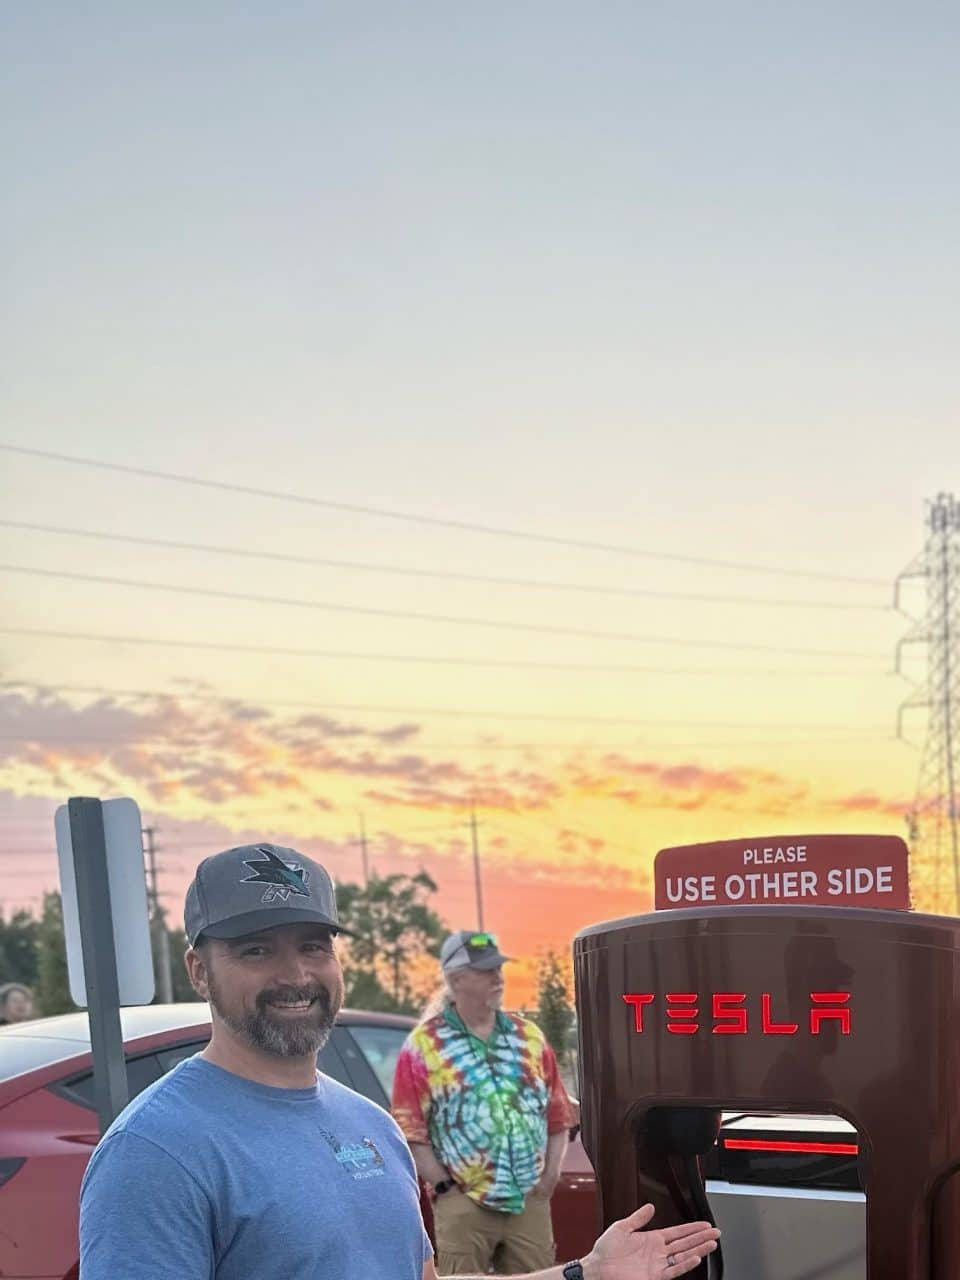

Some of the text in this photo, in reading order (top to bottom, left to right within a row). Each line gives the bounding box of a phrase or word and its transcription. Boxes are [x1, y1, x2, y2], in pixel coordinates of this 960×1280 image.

[743, 846, 807, 865] PLEASE
[665, 866, 894, 903] USE OTHER SIDE
[622, 992, 852, 1035] TESLA
